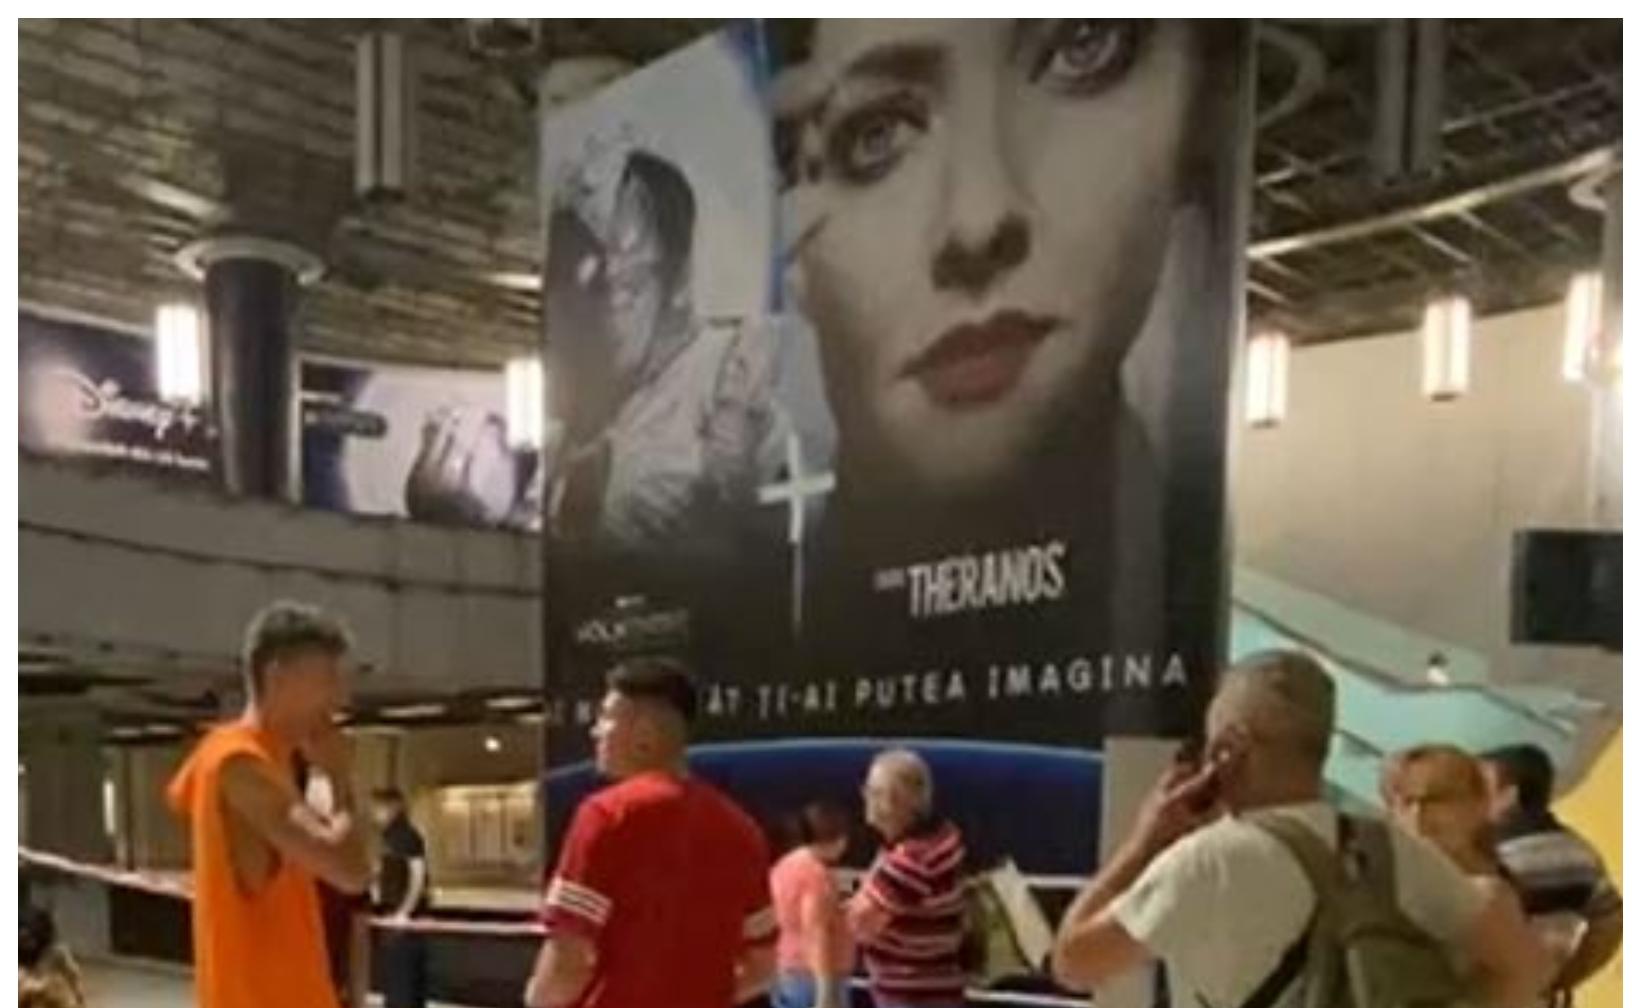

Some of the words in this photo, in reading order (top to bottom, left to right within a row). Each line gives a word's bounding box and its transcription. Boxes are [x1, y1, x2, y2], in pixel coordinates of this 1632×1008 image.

[908, 541, 1066, 618] THERANOS
[855, 669, 968, 708] PUTEA
[988, 653, 1187, 698] IMAGINA
